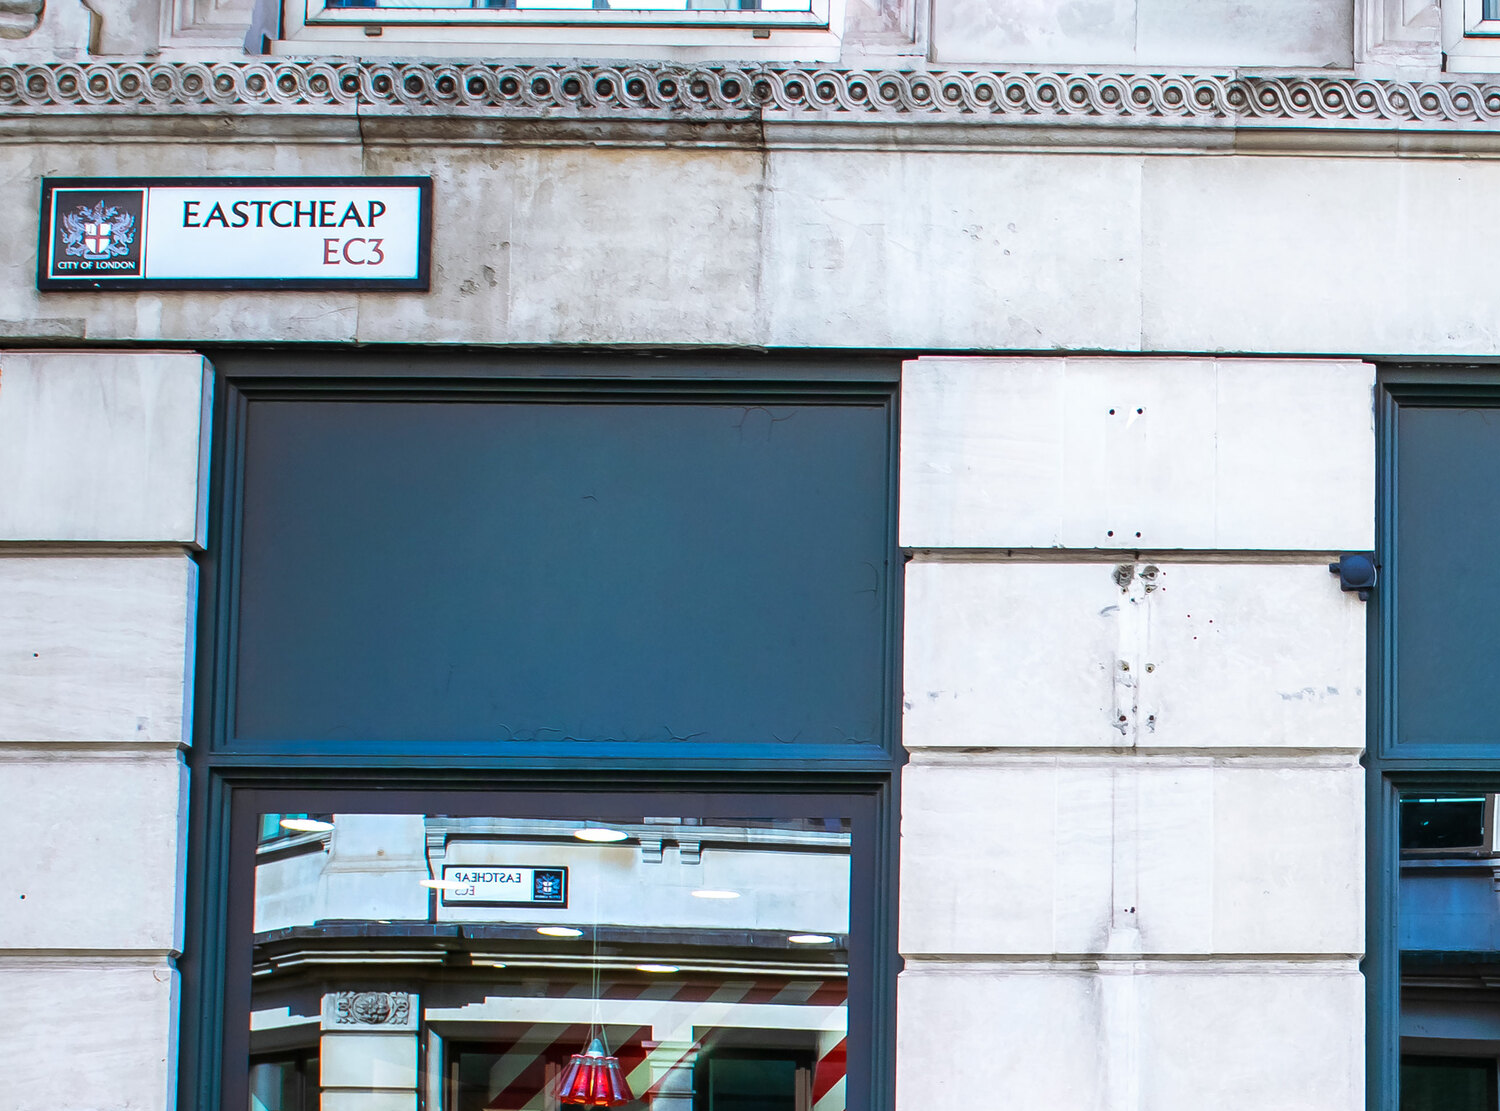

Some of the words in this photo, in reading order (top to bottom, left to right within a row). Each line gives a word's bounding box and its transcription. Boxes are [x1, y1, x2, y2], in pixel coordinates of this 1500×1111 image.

[182, 200, 387, 229] EASTCHEAP
[57, 261, 80, 270] CITY
[80, 261, 94, 270] OF
[95, 261, 136, 270] LONDON
[322, 238, 386, 266] EC3
